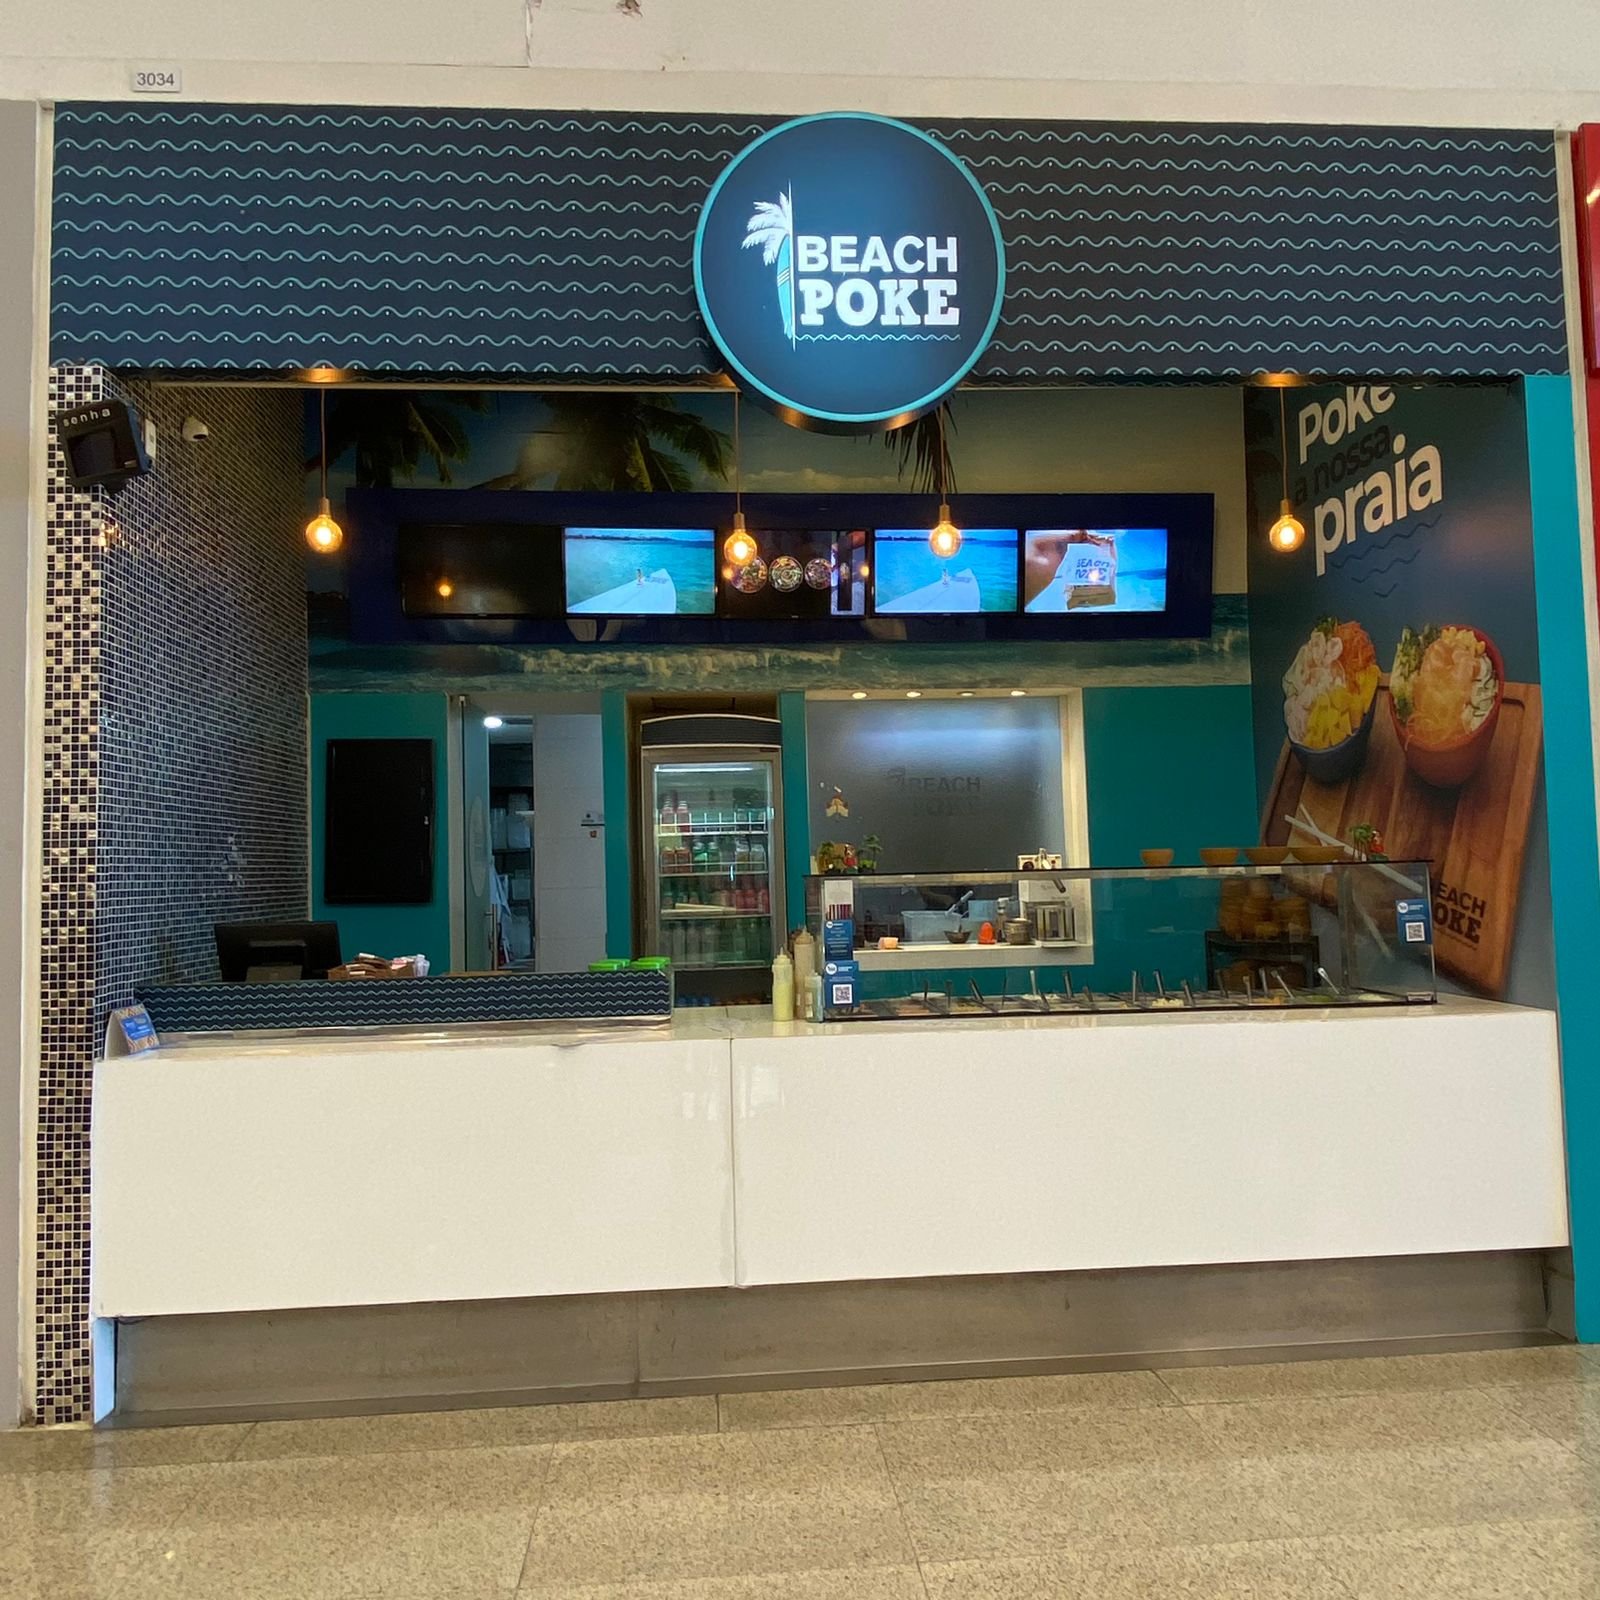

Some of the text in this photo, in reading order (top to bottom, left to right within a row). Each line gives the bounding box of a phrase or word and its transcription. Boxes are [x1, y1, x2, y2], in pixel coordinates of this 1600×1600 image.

[136, 72, 175, 86] 3034
[796, 235, 958, 273] BEACH
[799, 278, 960, 326] POKE
[63, 408, 111, 427] senha
[1313, 425, 1391, 495] nossa
[1314, 433, 1442, 577] praia
[1437, 882, 1487, 918] EACH
[1433, 902, 1482, 944] OKE
